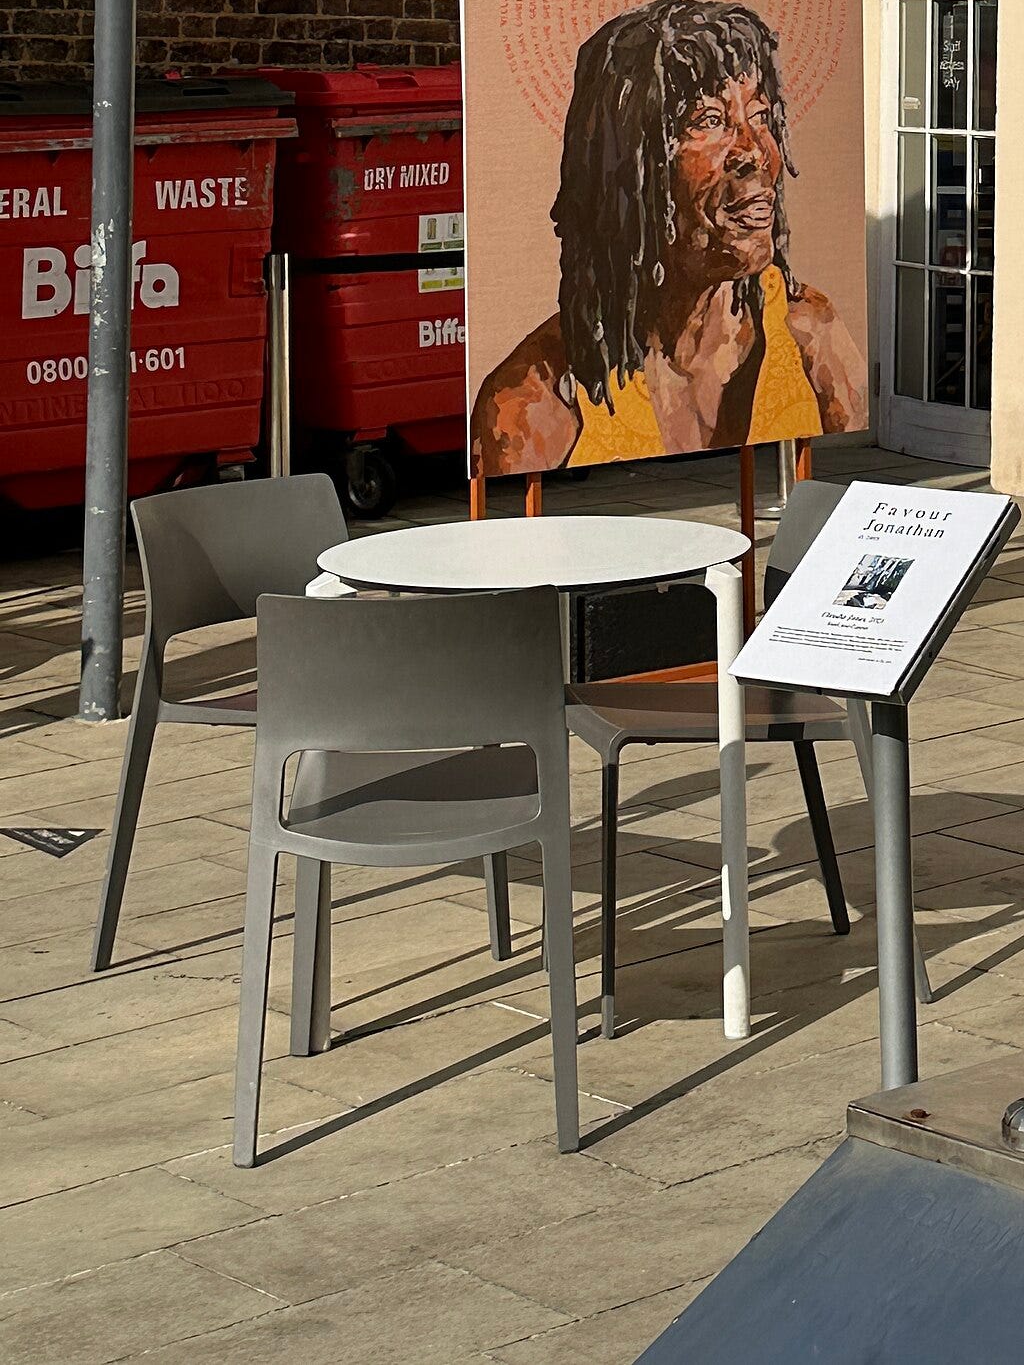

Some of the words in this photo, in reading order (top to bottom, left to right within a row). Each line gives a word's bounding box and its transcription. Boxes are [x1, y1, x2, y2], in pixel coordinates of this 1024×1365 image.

[364, 166, 395, 191] DRY
[400, 162, 450, 189] MIXED
[155, 176, 249, 210] WASTE
[26, 355, 88, 385] 0800
[872, 502, 953, 522] Favour
[862, 518, 945, 539] Jonathan
